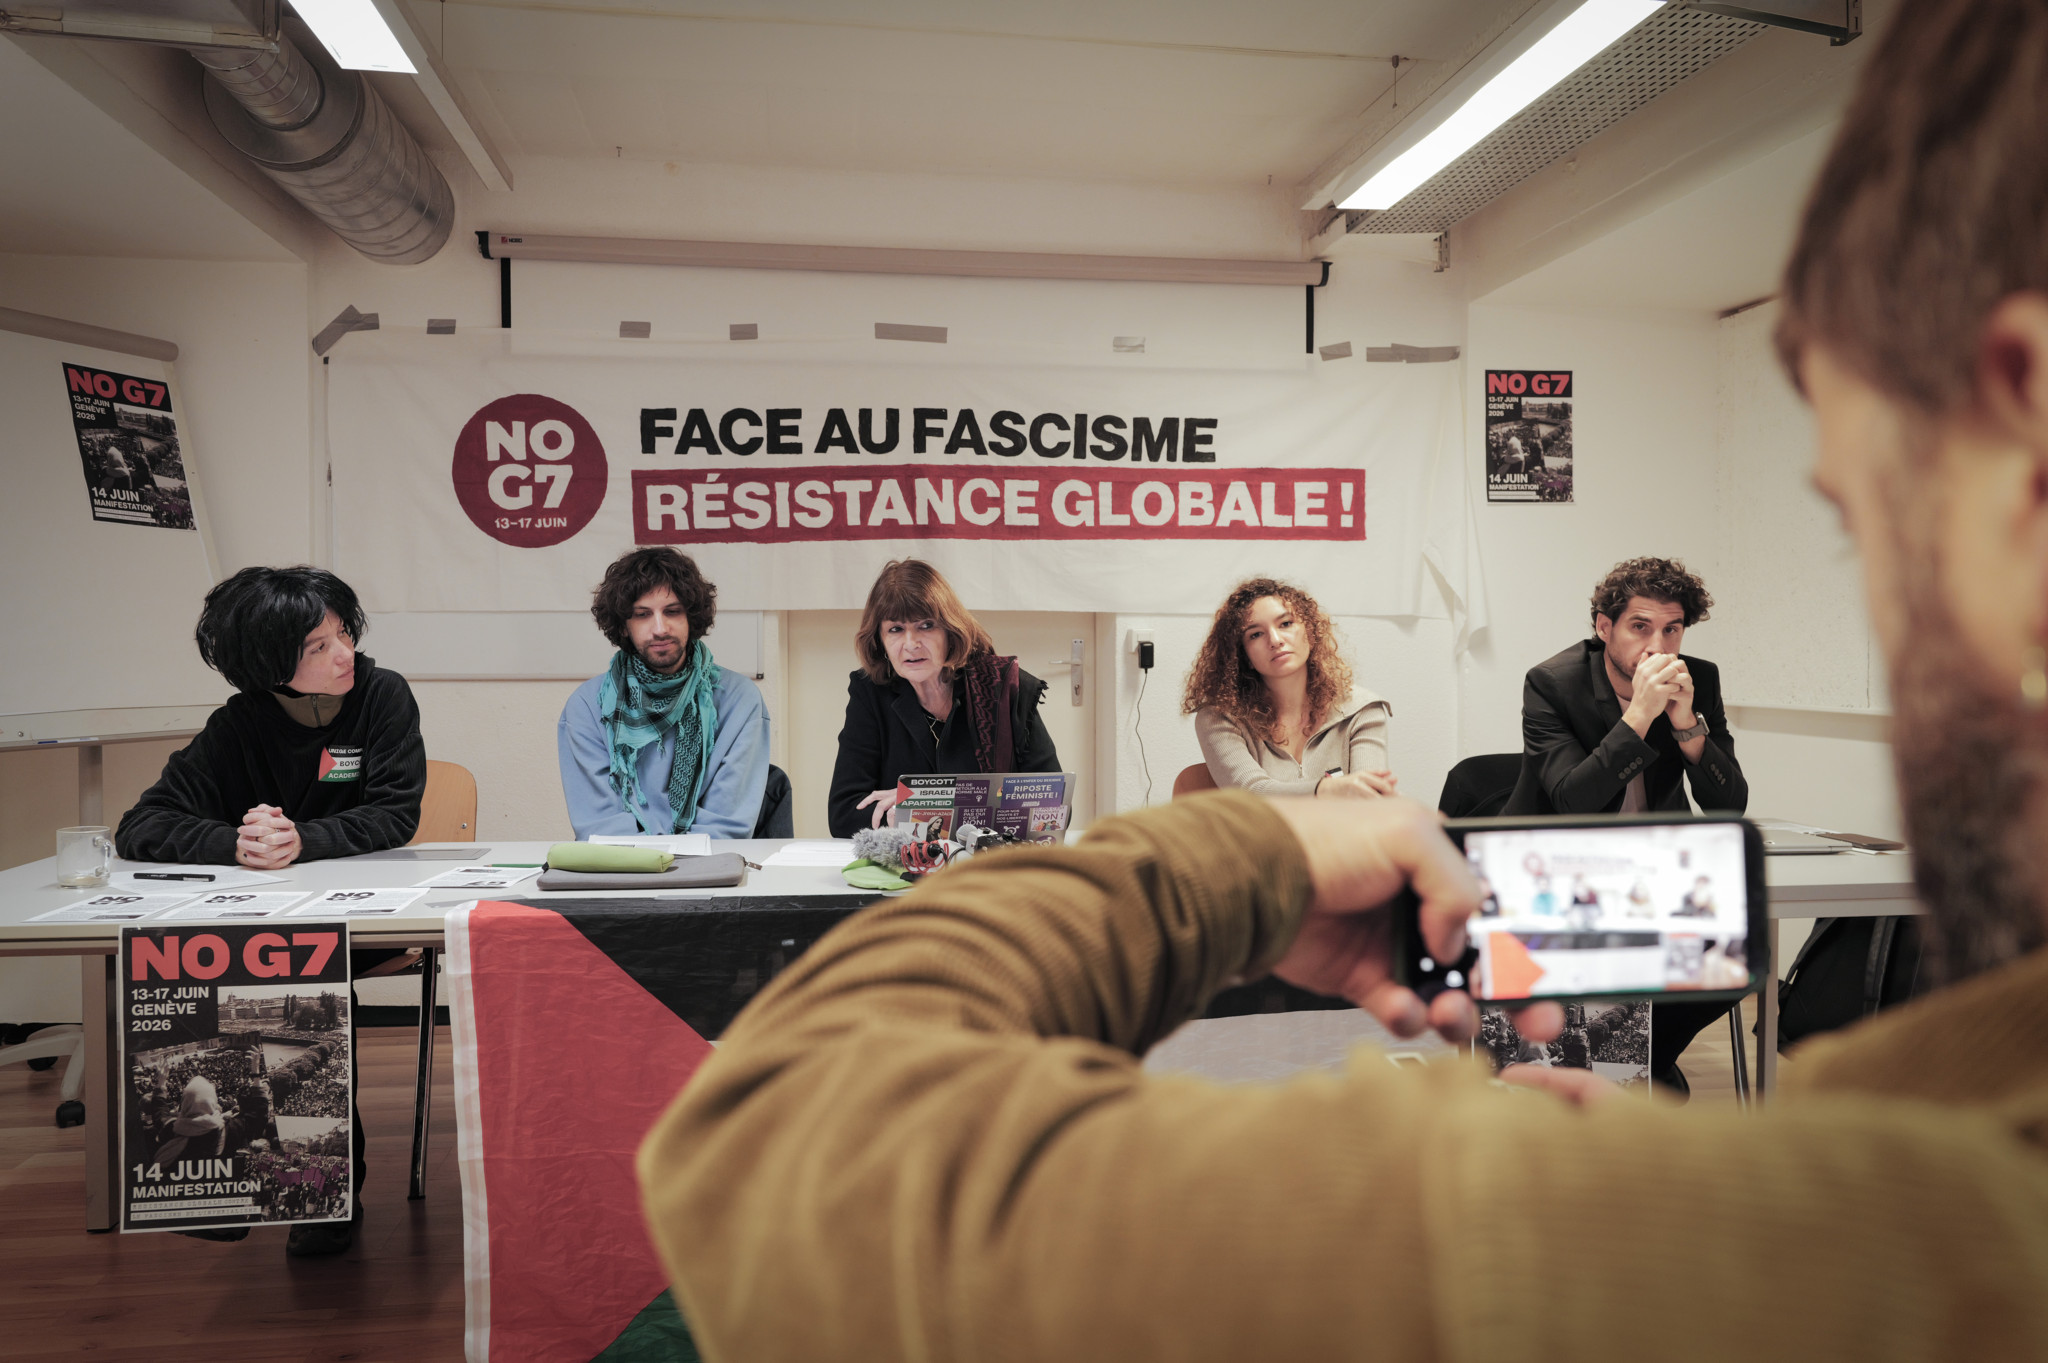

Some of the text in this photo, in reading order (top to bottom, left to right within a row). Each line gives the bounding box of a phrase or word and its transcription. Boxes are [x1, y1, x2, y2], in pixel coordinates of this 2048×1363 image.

[68, 368, 166, 406] NO G7
[1488, 373, 1570, 394] NO G7
[73, 395, 110, 408] 13-17 JUIN
[74, 402, 106, 414] GENÈVE
[76, 412, 96, 420] 2026
[485, 420, 575, 462] NO
[640, 408, 1218, 463] FACE AU FASCISME
[1489, 474, 1528, 483] 14 JUIN
[92, 486, 140, 502] 14 JUIN
[487, 464, 574, 510] G7
[94, 498, 154, 512] MANIFESTATION
[646, 473, 1040, 531] RÉSISTANCE
[1051, 479, 1328, 528] GLOBALE
[494, 516, 568, 529] 13-17 JUIN
[131, 932, 339, 981] NO G7
[131, 986, 209, 1000] 13-17 JUIN
[131, 1000, 197, 1016] GENÈVE
[132, 1019, 172, 1032] 2026
[133, 1158, 233, 1183] 14 JUIN
[133, 1180, 261, 1199] MANIFESTATION
